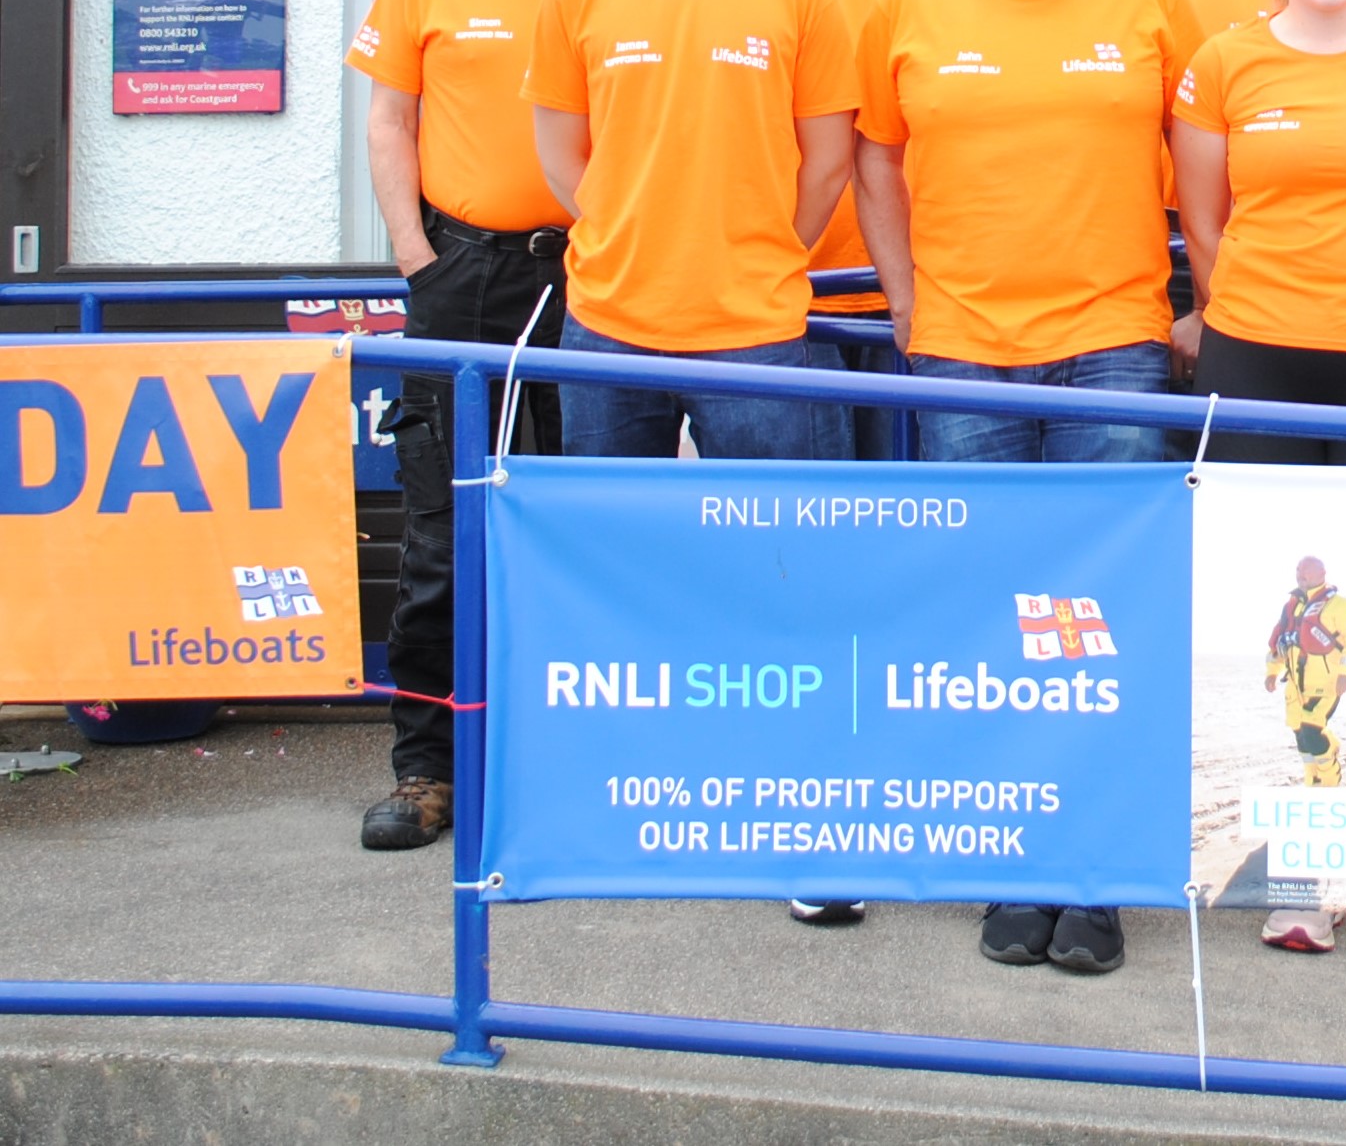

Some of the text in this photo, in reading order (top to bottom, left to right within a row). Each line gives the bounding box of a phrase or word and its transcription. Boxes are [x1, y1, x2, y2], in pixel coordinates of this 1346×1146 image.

[175, 5, 213, 13] information
[140, 28, 198, 38] 0800 543210
[139, 43, 206, 54] www.rnli.org.uk
[616, 39, 649, 52] James
[712, 47, 768, 70] Lifeboats
[957, 51, 982, 62] John
[1062, 59, 1125, 73] Lifeboats
[142, 82, 264, 93] 999 in any marine emergency
[142, 94, 238, 105] and ask for Coastguard
[0, 373, 316, 515] DAY
[700, 497, 968, 528] RNLI KIPPFORD
[129, 627, 325, 666] Lifeboats
[546, 660, 1120, 714] RNLI SHOP Lifeboats
[606, 776, 1060, 812] 100% OF PROFIT SUPPORTS
[639, 821, 1026, 856] OUR LIFESAVING WORK
